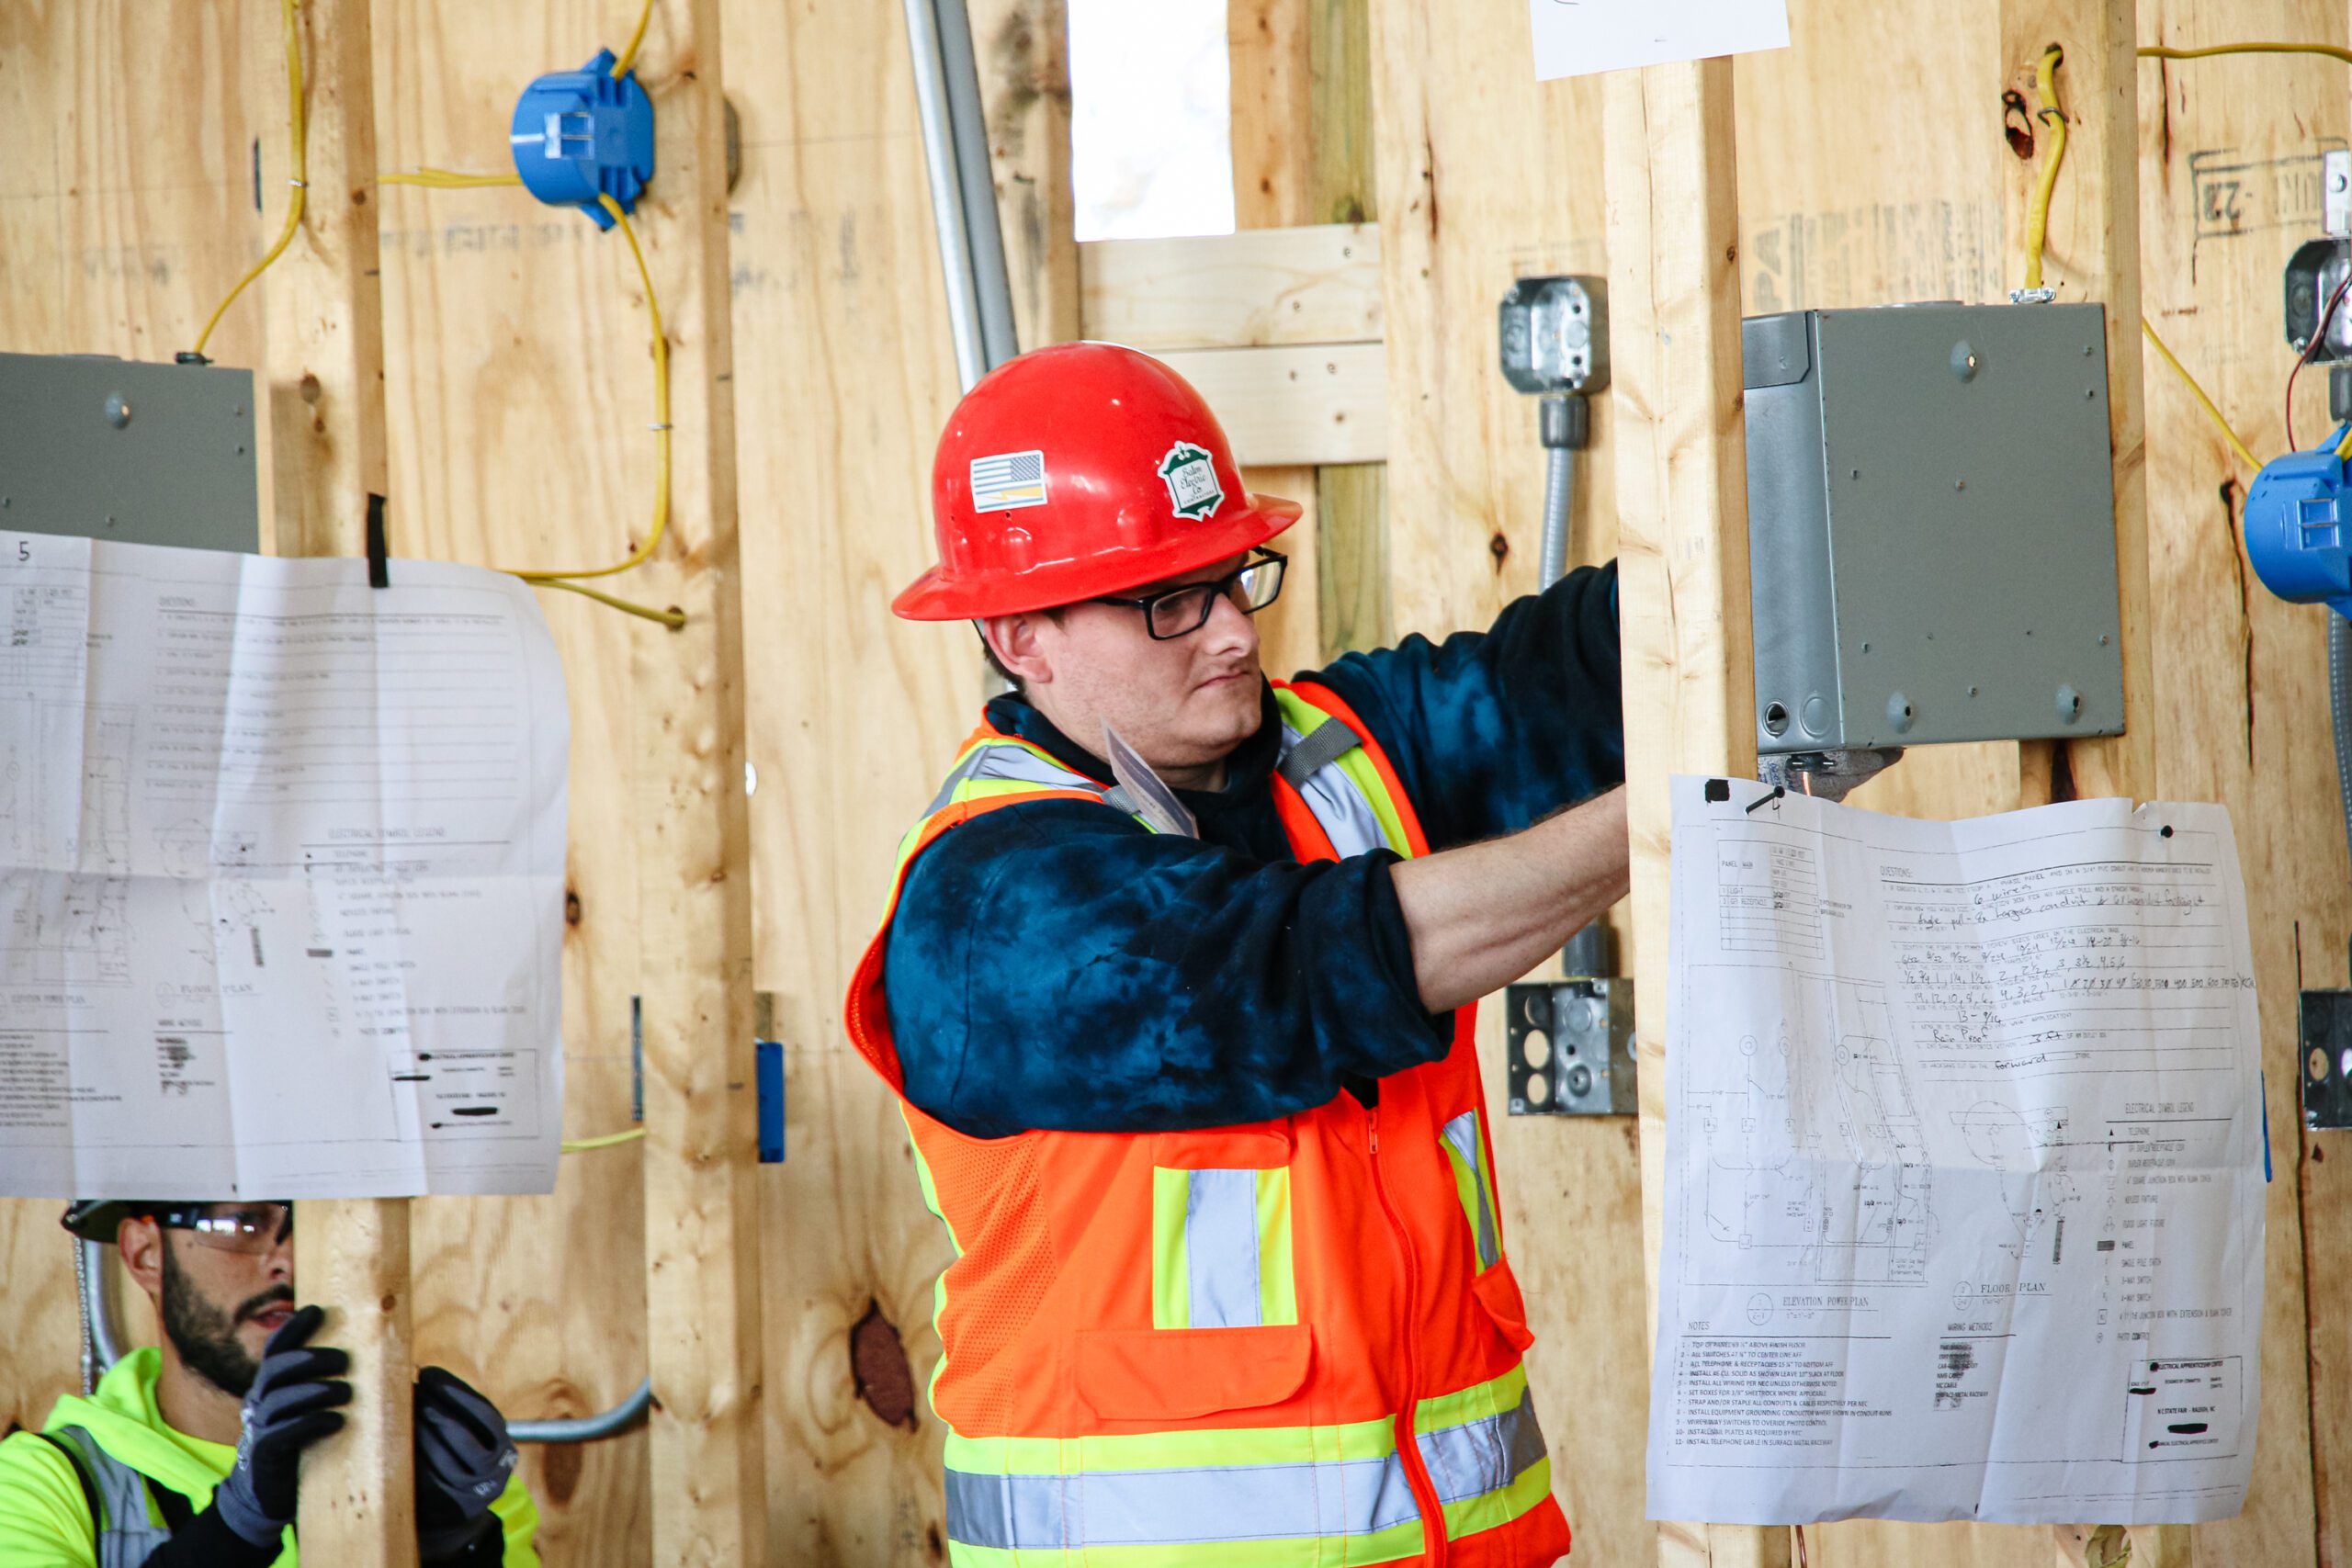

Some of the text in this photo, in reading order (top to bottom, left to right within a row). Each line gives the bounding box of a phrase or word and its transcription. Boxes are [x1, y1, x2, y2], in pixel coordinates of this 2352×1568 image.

[1182, 465, 1203, 477] Salem
[1180, 475, 1206, 490] Electric
[18, 541, 30, 562] 5
[1980, 1281, 2047, 1294] FLOOR PLAN
[1782, 1295, 1823, 1307] ELEVATION
[1849, 1295, 1870, 1308] PLAN
[1688, 1321, 1711, 1331] NOTES
[1968, 1321, 1993, 1331] METHODS
